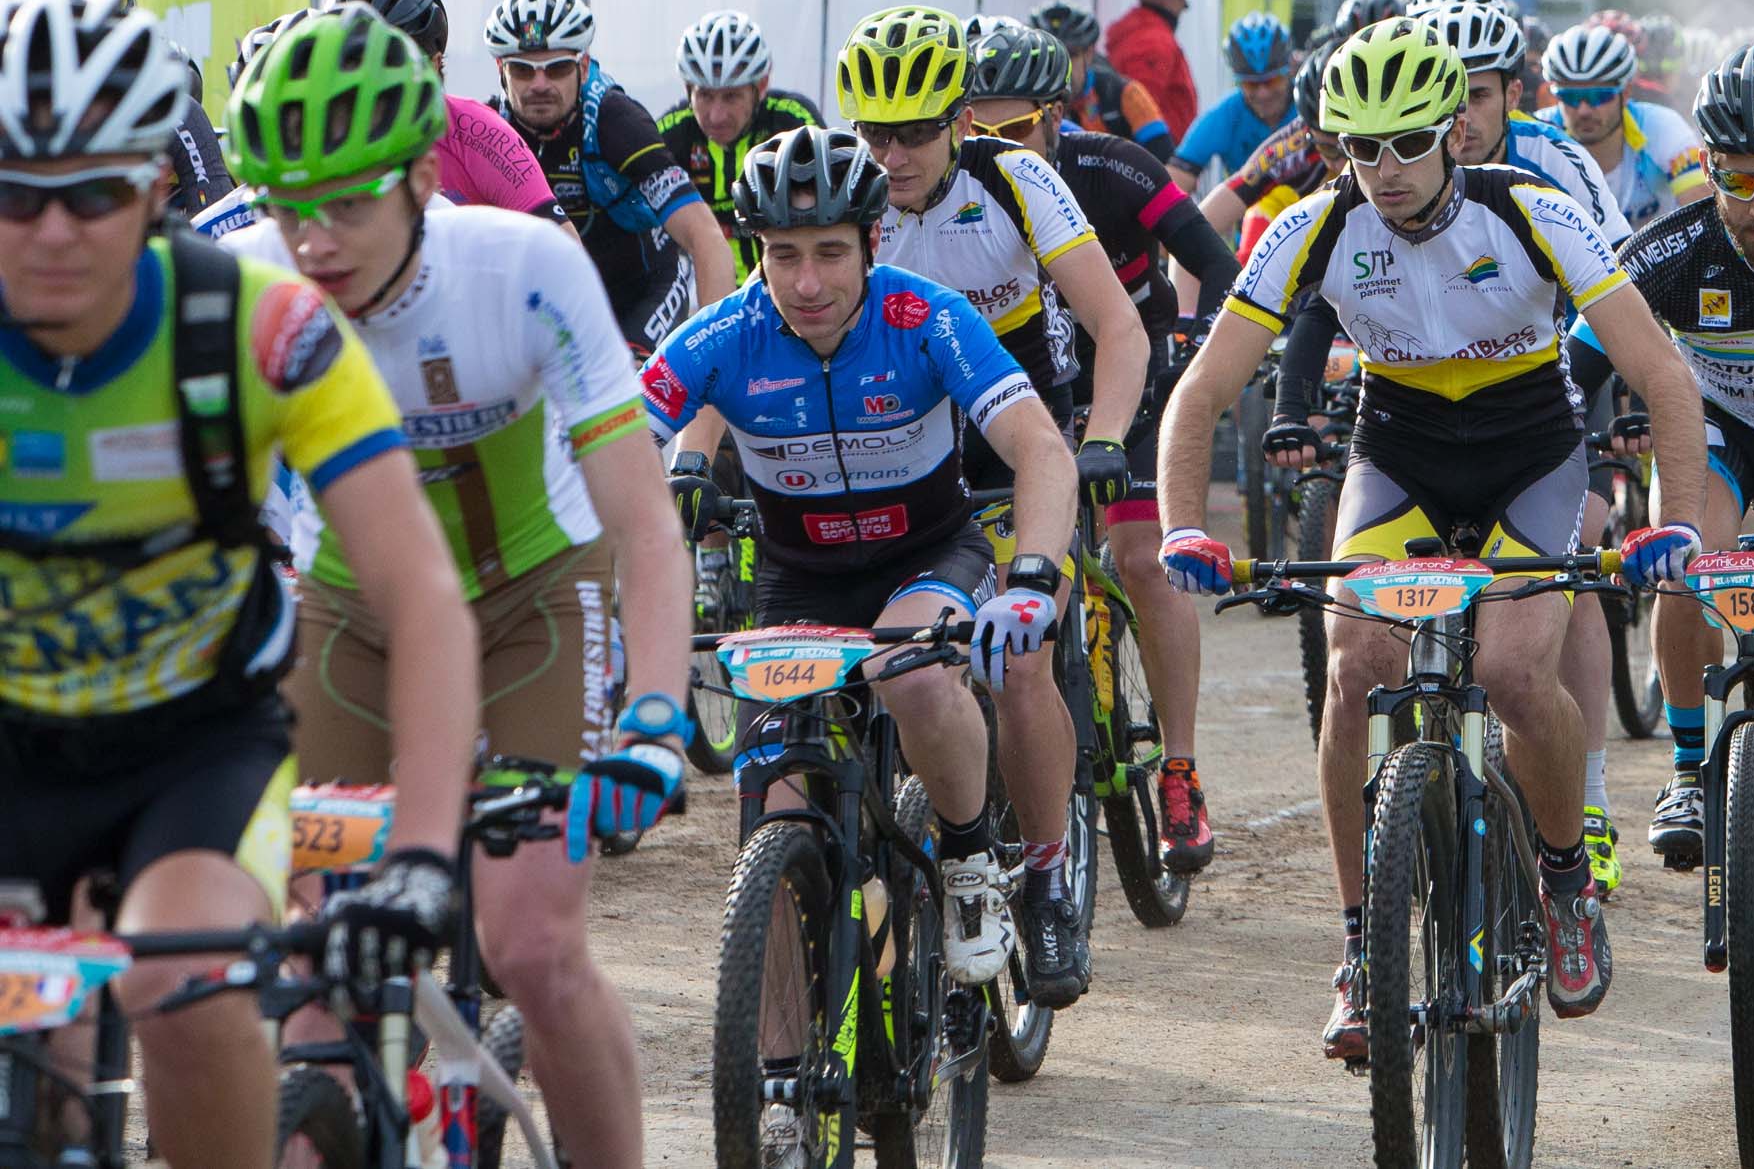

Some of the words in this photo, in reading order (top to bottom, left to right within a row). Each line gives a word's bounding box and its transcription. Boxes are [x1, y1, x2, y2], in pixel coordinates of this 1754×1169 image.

[1642, 231, 1688, 269] MEUSE
[1689, 220, 1705, 242] 55
[1353, 277, 1402, 291] seyssinet
[1360, 286, 1397, 300] pariset
[684, 309, 745, 351] SIMON
[788, 422, 925, 456] DEMOLY
[824, 466, 911, 485] Ornans
[1396, 588, 1439, 607] 1317
[763, 663, 816, 687] 1644
[1708, 866, 1722, 907] LEON
